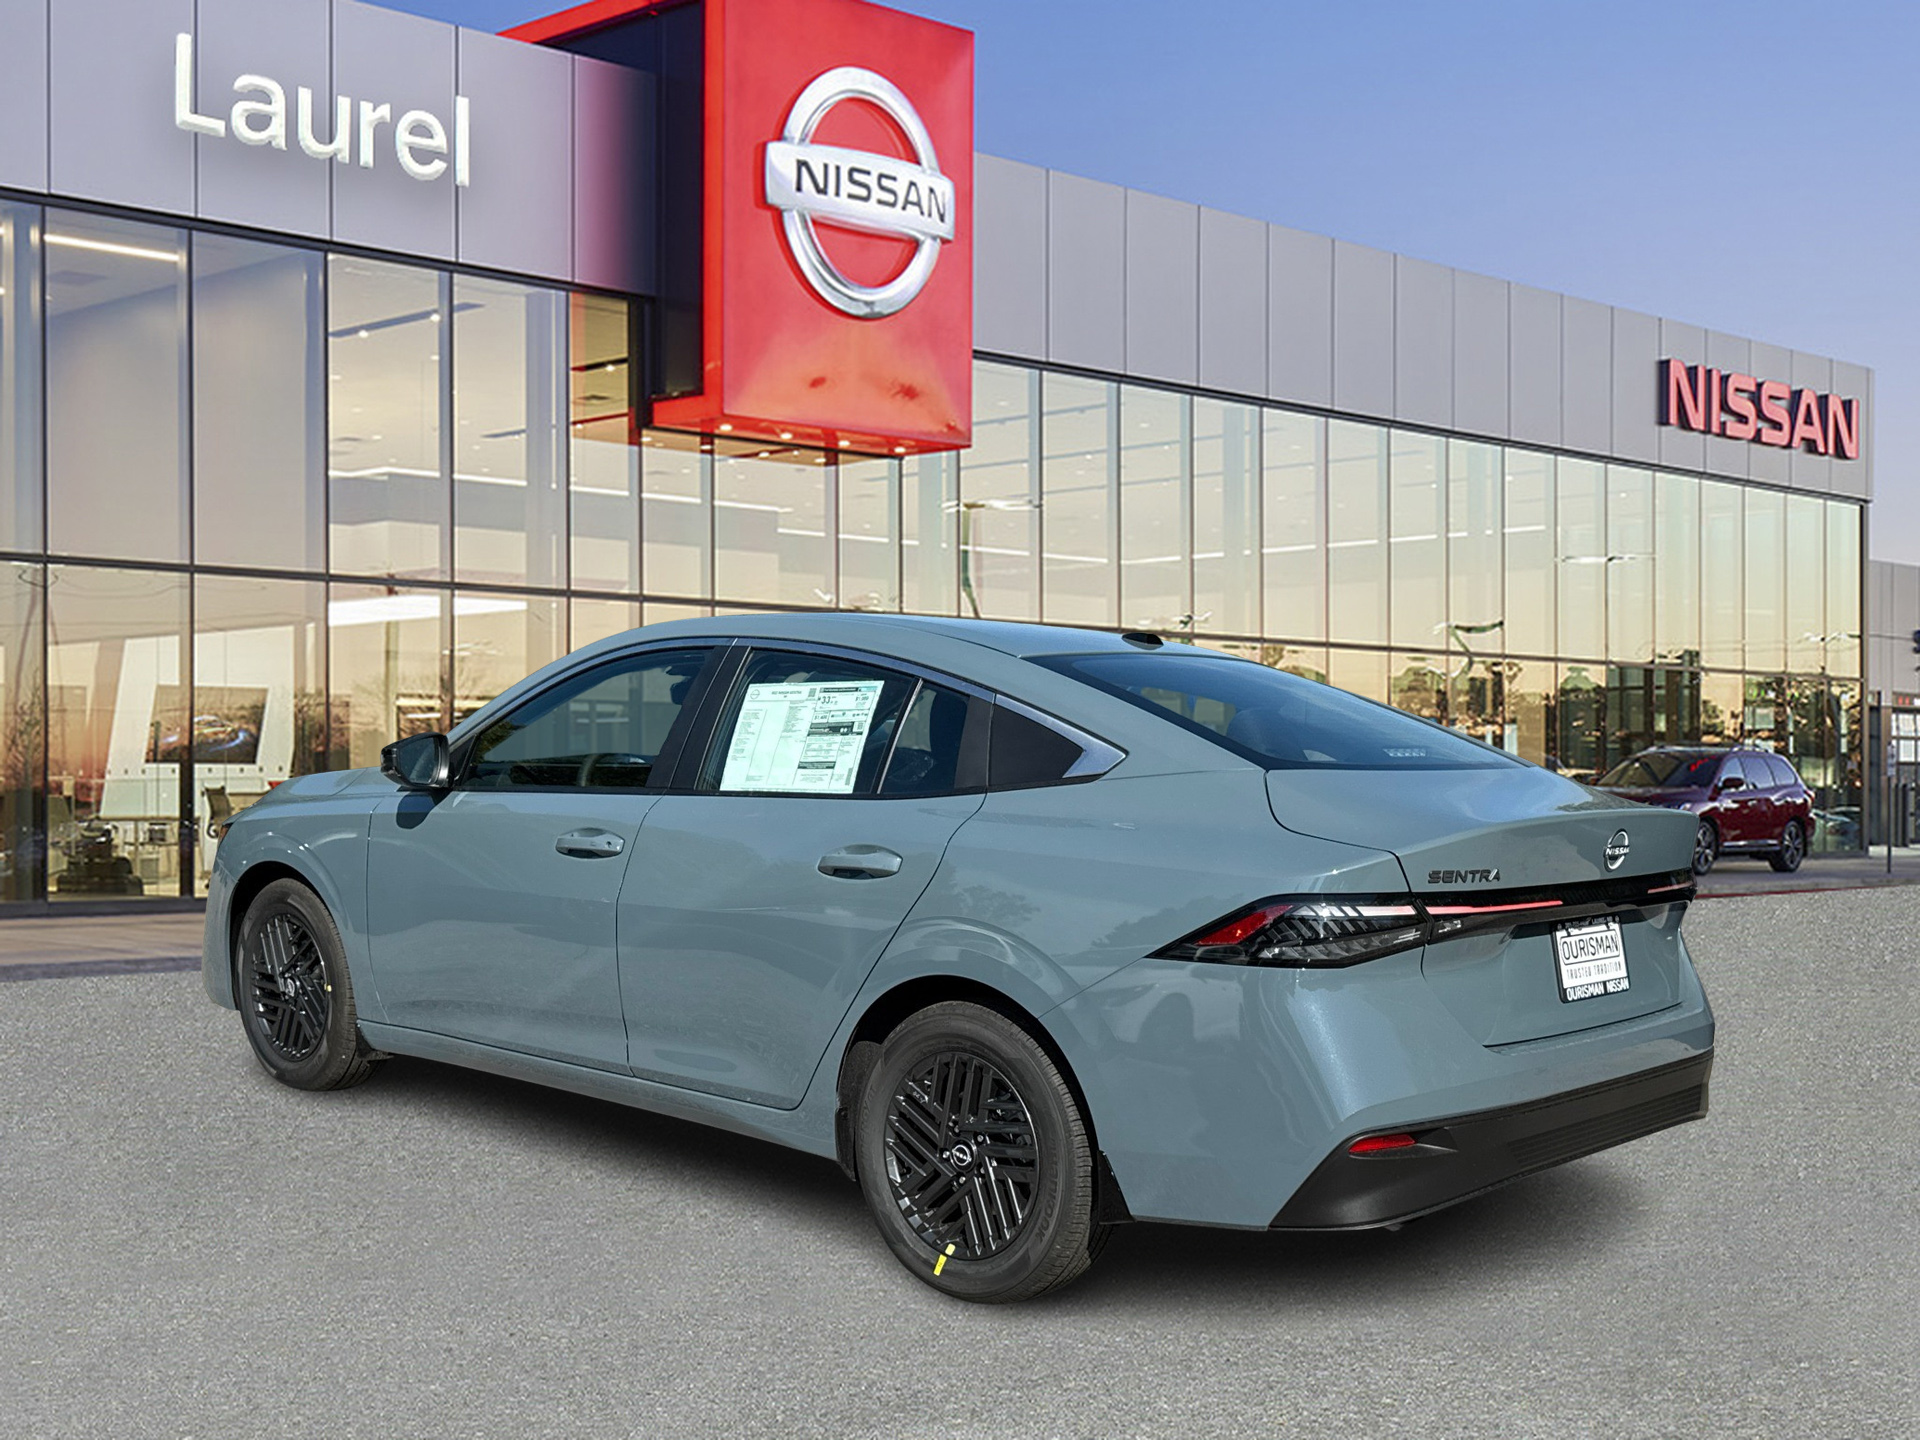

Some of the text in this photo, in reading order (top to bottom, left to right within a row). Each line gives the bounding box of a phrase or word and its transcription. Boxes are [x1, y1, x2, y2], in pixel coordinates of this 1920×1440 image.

[174, 33, 471, 188] Laurel
[795, 158, 947, 224] NISSAN
[1659, 358, 1860, 460] NISSAN
[1605, 847, 1630, 856] NISSAN
[1427, 868, 1501, 884] SENTRA
[1561, 933, 1619, 961] OURISMAN
[1566, 960, 1622, 980] TRUSTED TRADITION
[1566, 977, 1630, 1001] OURISMAN NISSAN
